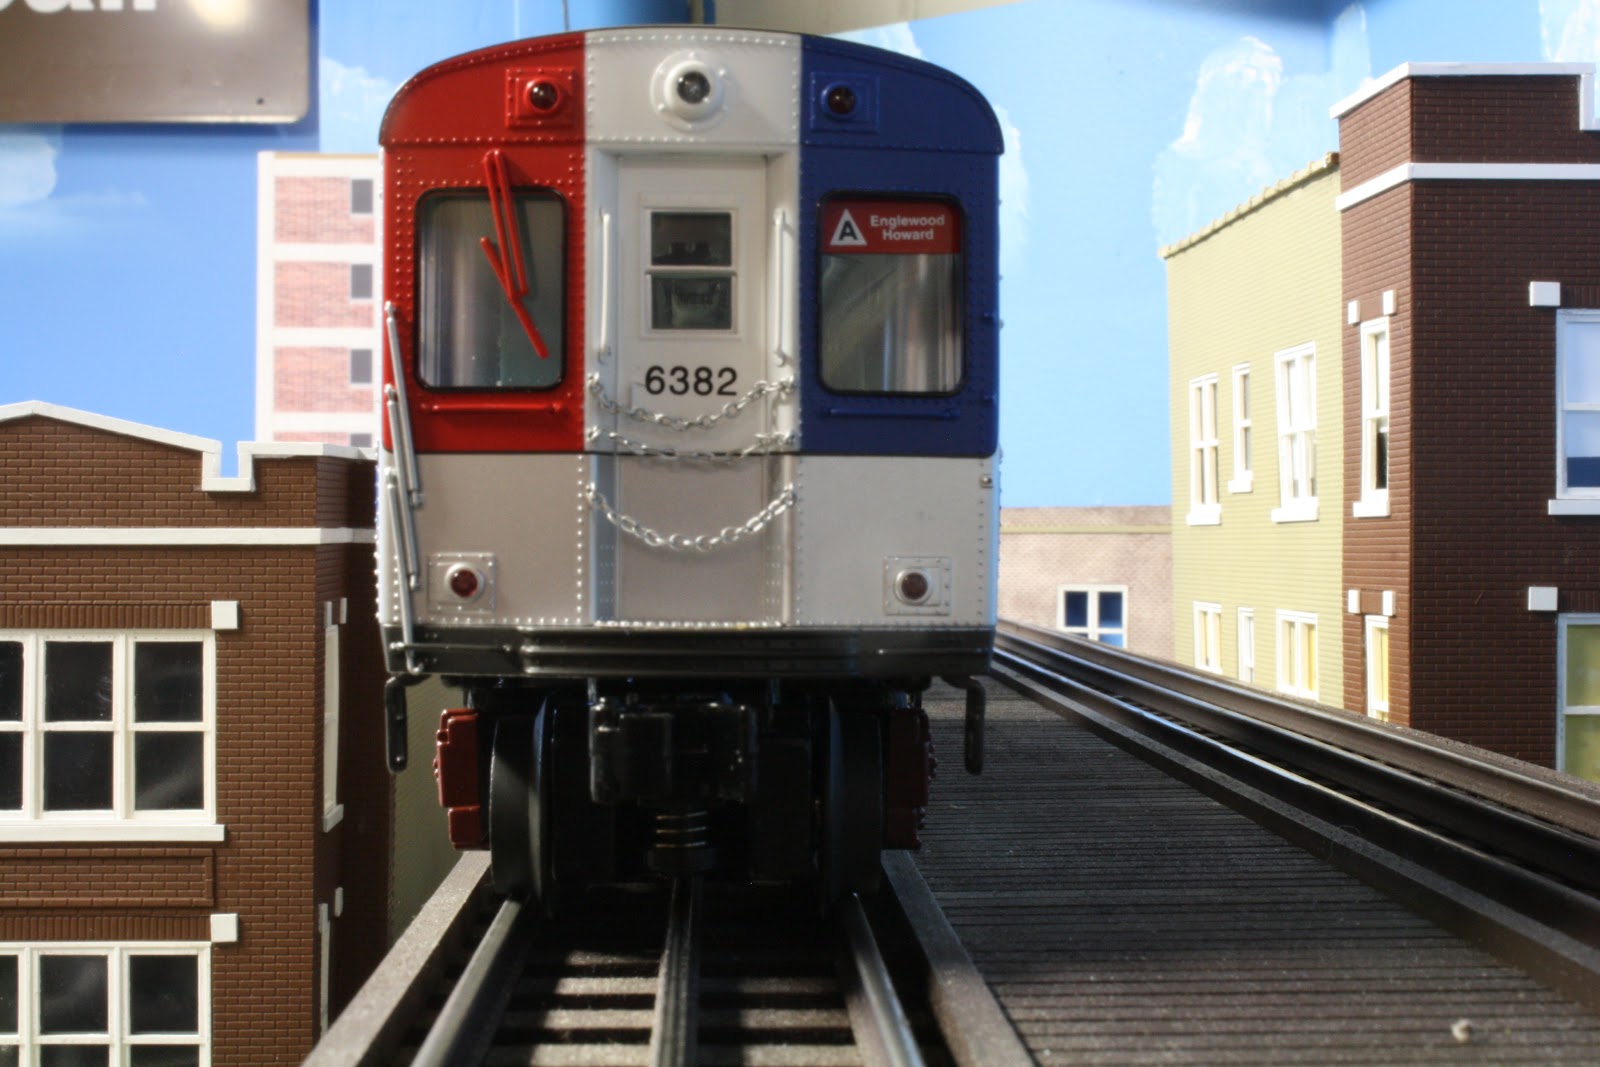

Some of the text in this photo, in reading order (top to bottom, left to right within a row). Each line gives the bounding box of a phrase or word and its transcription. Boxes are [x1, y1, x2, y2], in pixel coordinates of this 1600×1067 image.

[838, 220, 858, 241] A
[869, 214, 946, 229] Englewood
[882, 228, 935, 241] Howard
[645, 365, 737, 396] 6382
